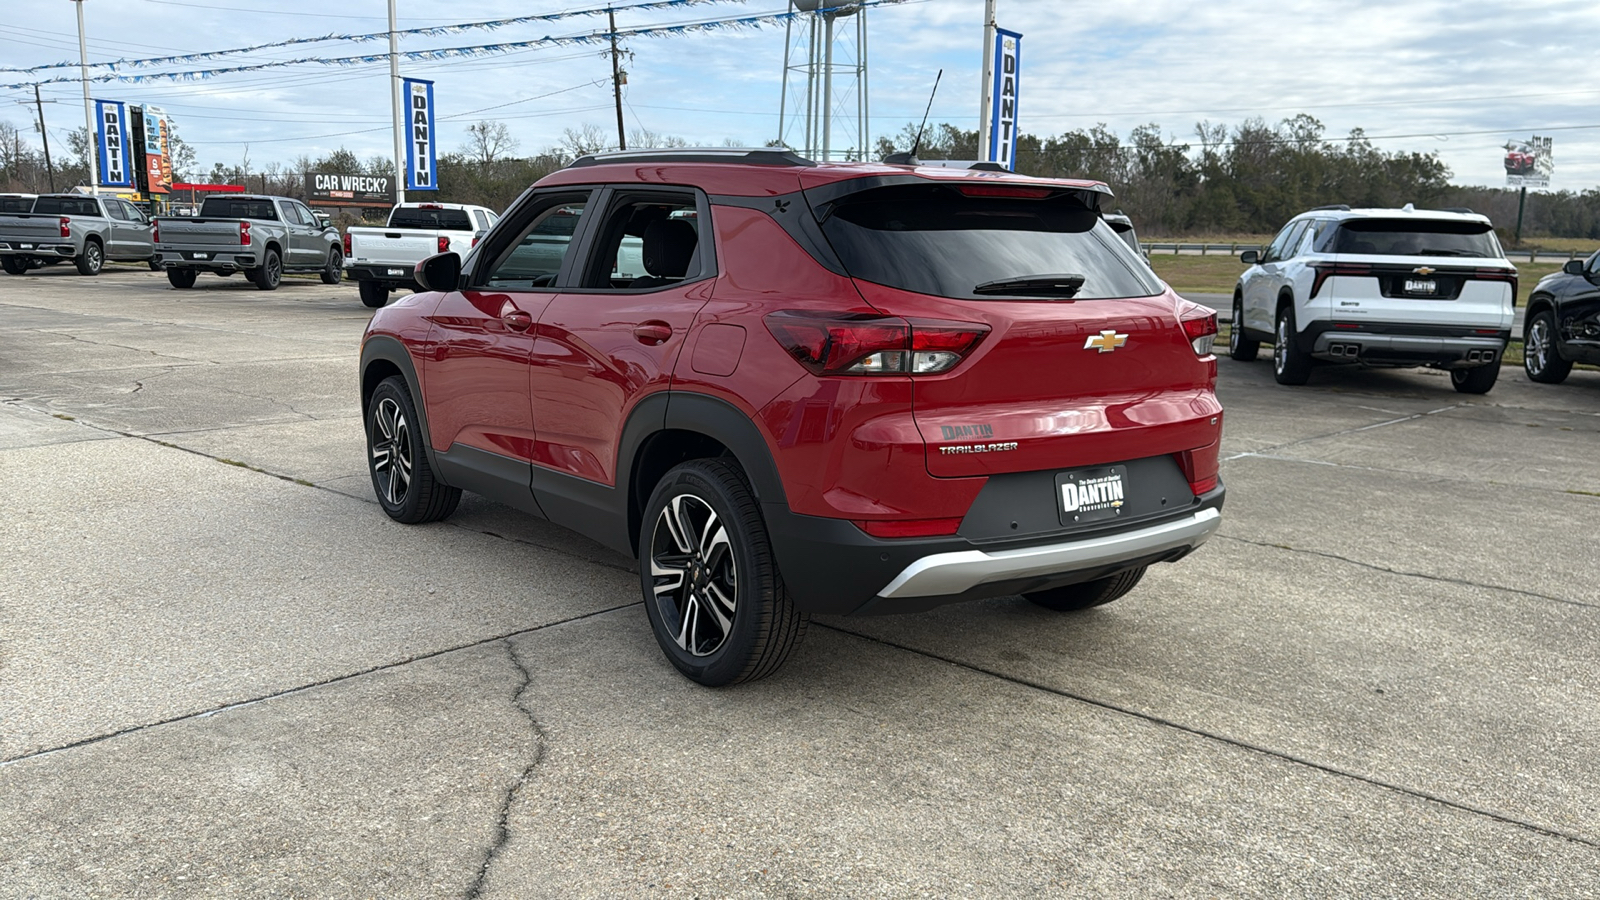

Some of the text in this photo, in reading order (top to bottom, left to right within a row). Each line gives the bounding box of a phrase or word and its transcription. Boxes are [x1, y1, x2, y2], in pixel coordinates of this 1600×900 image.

[1001, 53, 1015, 170] DANTI
[105, 112, 122, 182] DANTIN
[413, 94, 430, 186] DANTIN
[315, 174, 388, 193] CAR WRECK?
[1405, 280, 1436, 290] DANTIN
[940, 423, 994, 441] DANTIN
[939, 442, 1018, 455] TRAILBLAZER
[1061, 480, 1124, 513] DANTIN
